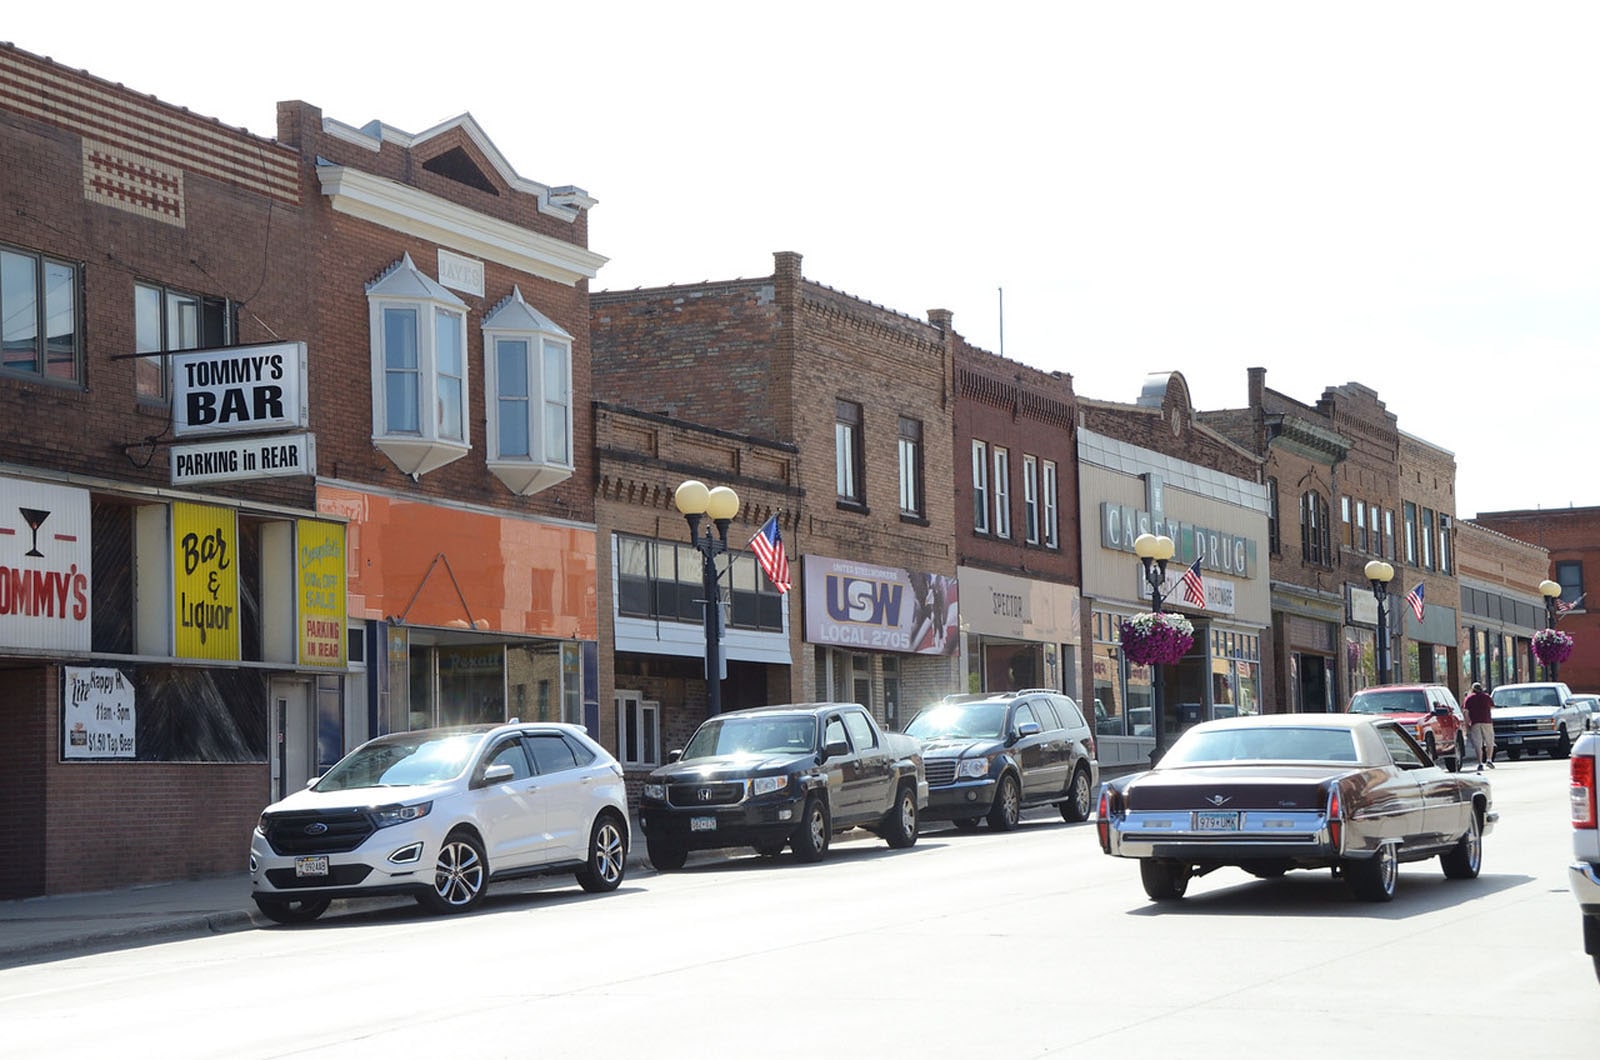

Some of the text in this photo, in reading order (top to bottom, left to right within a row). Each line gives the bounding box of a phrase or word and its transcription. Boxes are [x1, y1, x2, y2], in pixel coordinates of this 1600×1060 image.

[184, 355, 283, 388] TOMMY'S
[186, 385, 284, 426] BAR
[177, 445, 298, 477] PARKING in REAR
[182, 528, 230, 576] Bar
[1196, 531, 1245, 572] DRUG
[208, 571, 221, 600] &
[306, 590, 336, 609] SALE
[826, 574, 904, 627] USW
[993, 591, 1023, 617] SPECTOR
[182, 592, 232, 645] Liquor
[306, 620, 339, 640] PARKING
[307, 641, 339, 658] IN REAR
[820, 623, 911, 649] LOCAL 2705
[72, 678, 90, 708] Lite
[90, 671, 114, 694] Happy
[120, 733, 133, 751] Beer
